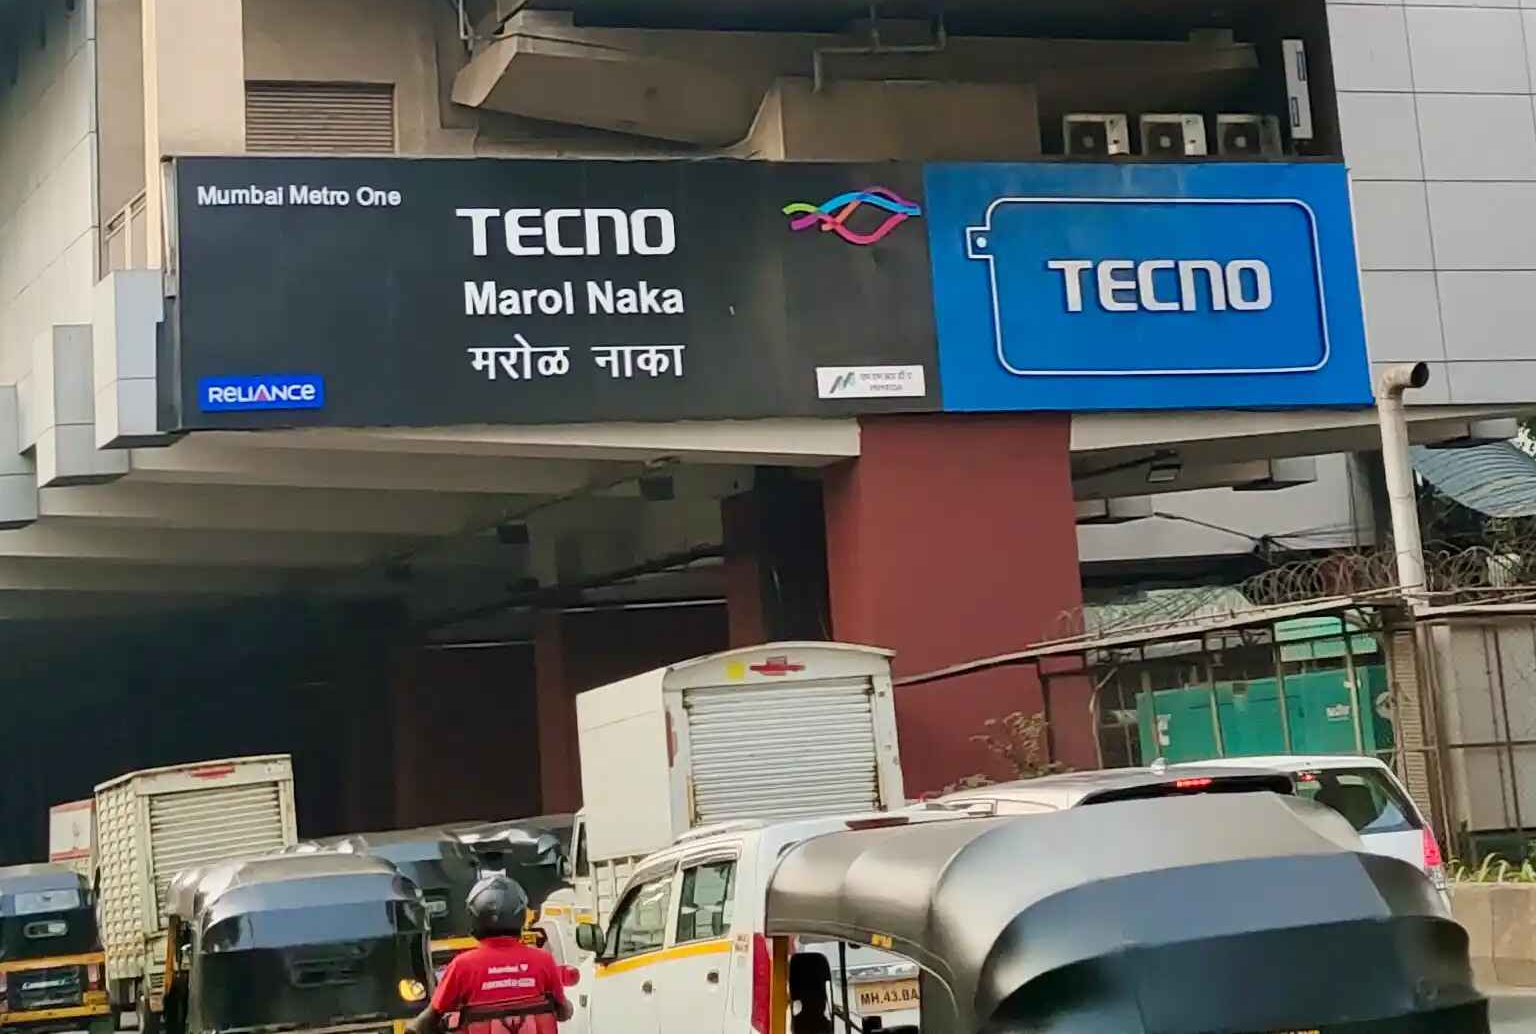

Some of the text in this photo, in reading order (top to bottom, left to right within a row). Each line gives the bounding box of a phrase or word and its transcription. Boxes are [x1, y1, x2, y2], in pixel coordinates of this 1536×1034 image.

[197, 185, 402, 206] Mumbai Metro One
[455, 208, 676, 256] TECNO
[464, 281, 684, 315] Marol Naka
[1047, 259, 1272, 312] TECNO
[467, 333, 685, 380] मरोळ नाका
